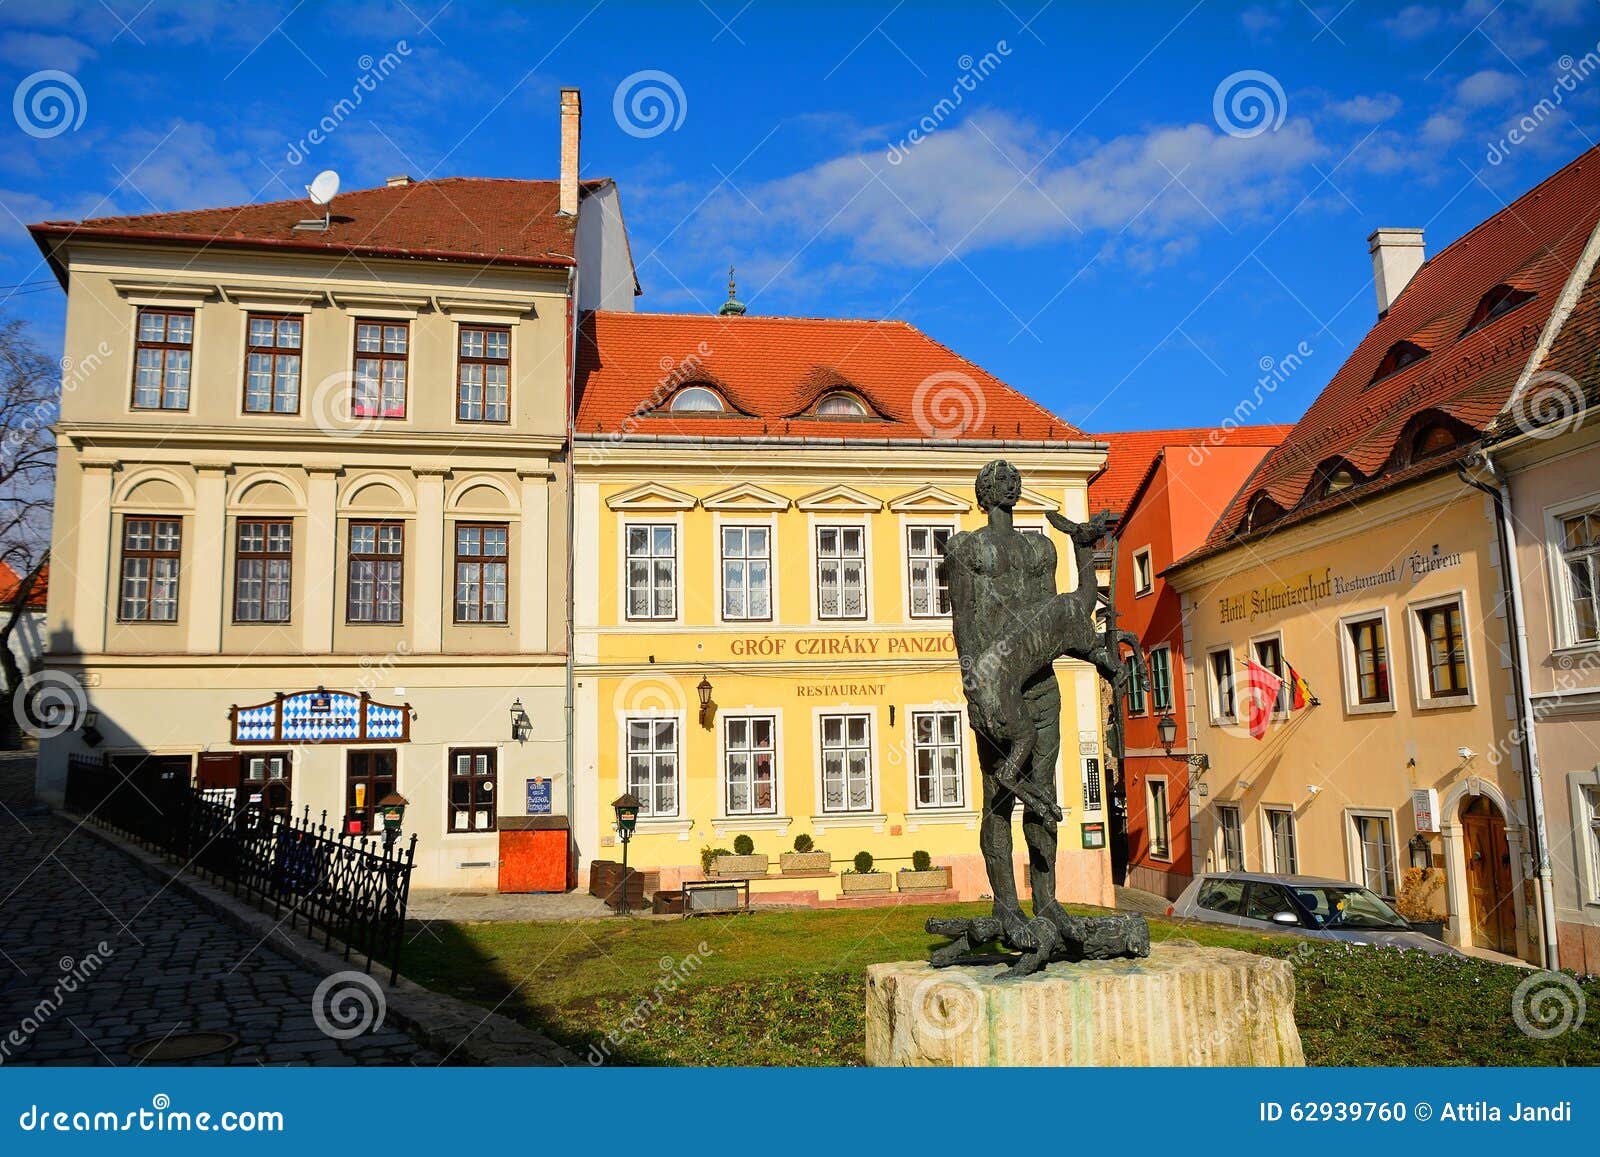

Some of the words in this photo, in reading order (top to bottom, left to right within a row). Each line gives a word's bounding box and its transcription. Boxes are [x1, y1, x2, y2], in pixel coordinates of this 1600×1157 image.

[1334, 566, 1396, 595] Restaurant
[730, 635, 786, 656] GRÓF
[795, 635, 879, 655] CZIRÁKY
[888, 633, 956, 653] PANZIÓ
[796, 683, 885, 697] RESTAURANT
